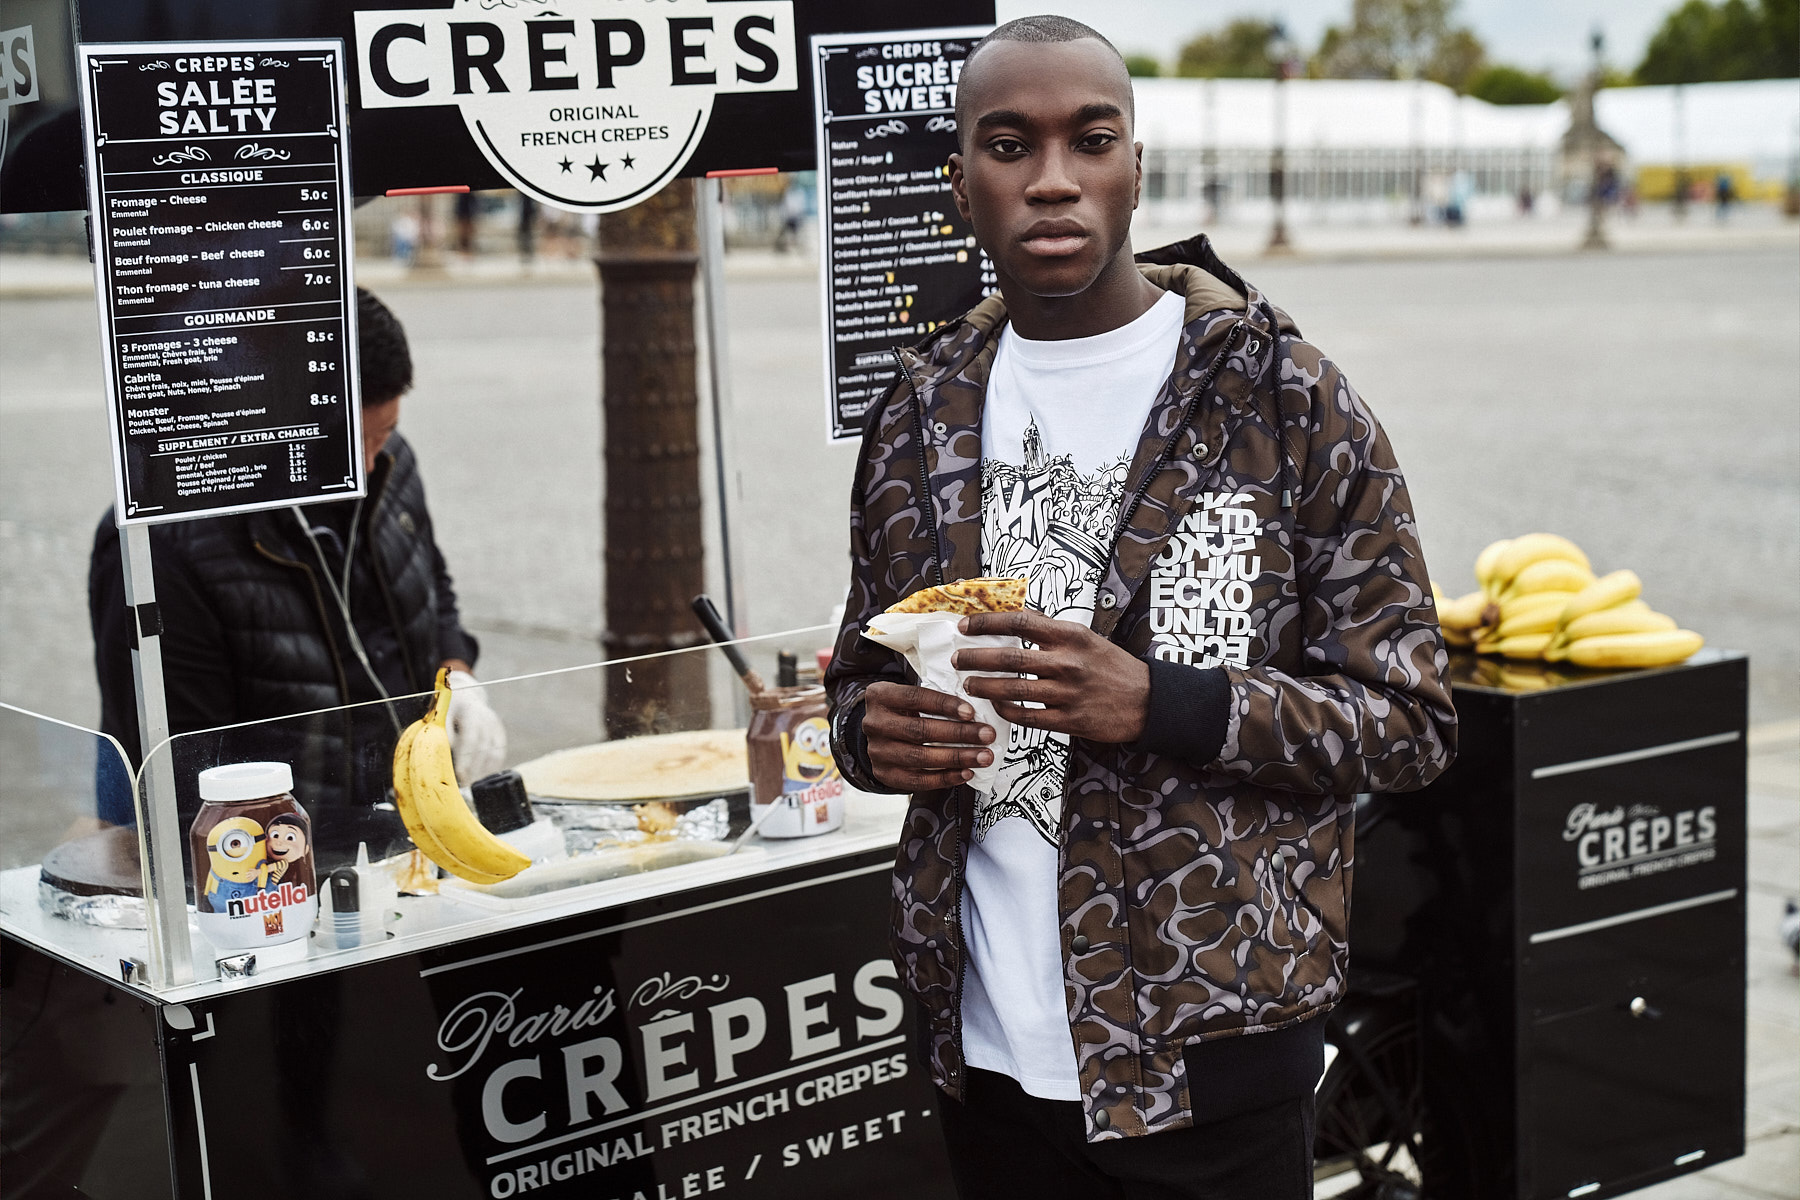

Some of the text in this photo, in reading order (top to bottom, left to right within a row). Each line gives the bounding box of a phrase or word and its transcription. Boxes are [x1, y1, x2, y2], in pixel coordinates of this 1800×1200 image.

[369, 11, 779, 98] CRÊPES
[175, 56, 254, 72] CRÊPES
[157, 77, 276, 107] SALÉE
[159, 107, 276, 134] SALTY
[549, 105, 639, 121] ORIGINAL
[521, 126, 669, 147] FRENCH CREPES
[180, 170, 263, 184] CLASSIQUE
[110, 195, 207, 208] Fromage Cheese
[111, 209, 148, 218] Emmental
[112, 219, 282, 237] Poulet fromage Chicken cheese
[113, 238, 150, 247] Emmental
[145, 254, 189, 264] fromage
[200, 249, 224, 260] Beef
[229, 249, 264, 259] cheese
[115, 267, 152, 276] Emmental
[116, 277, 260, 295] Thon fromage tuna cheese
[117, 295, 154, 305] Emmental
[184, 309, 275, 326] GOURMANDE
[121, 336, 237, 353] 3 Fromages 3 cheese
[124, 372, 161, 384] Cabrita
[127, 407, 169, 418] Monster
[240, 431, 275, 443] EXTRA
[277, 426, 319, 439] CHARGE
[1151, 578, 1253, 612] ECKO
[1150, 607, 1257, 637] UNLTD.
[228, 883, 307, 917] nutella
[426, 985, 616, 1082] Paris
[482, 959, 905, 1144] CRÊPES
[490, 1054, 908, 1200] ORIGINAL FRENCH CREPES
[783, 1110, 906, 1167] SWEET
